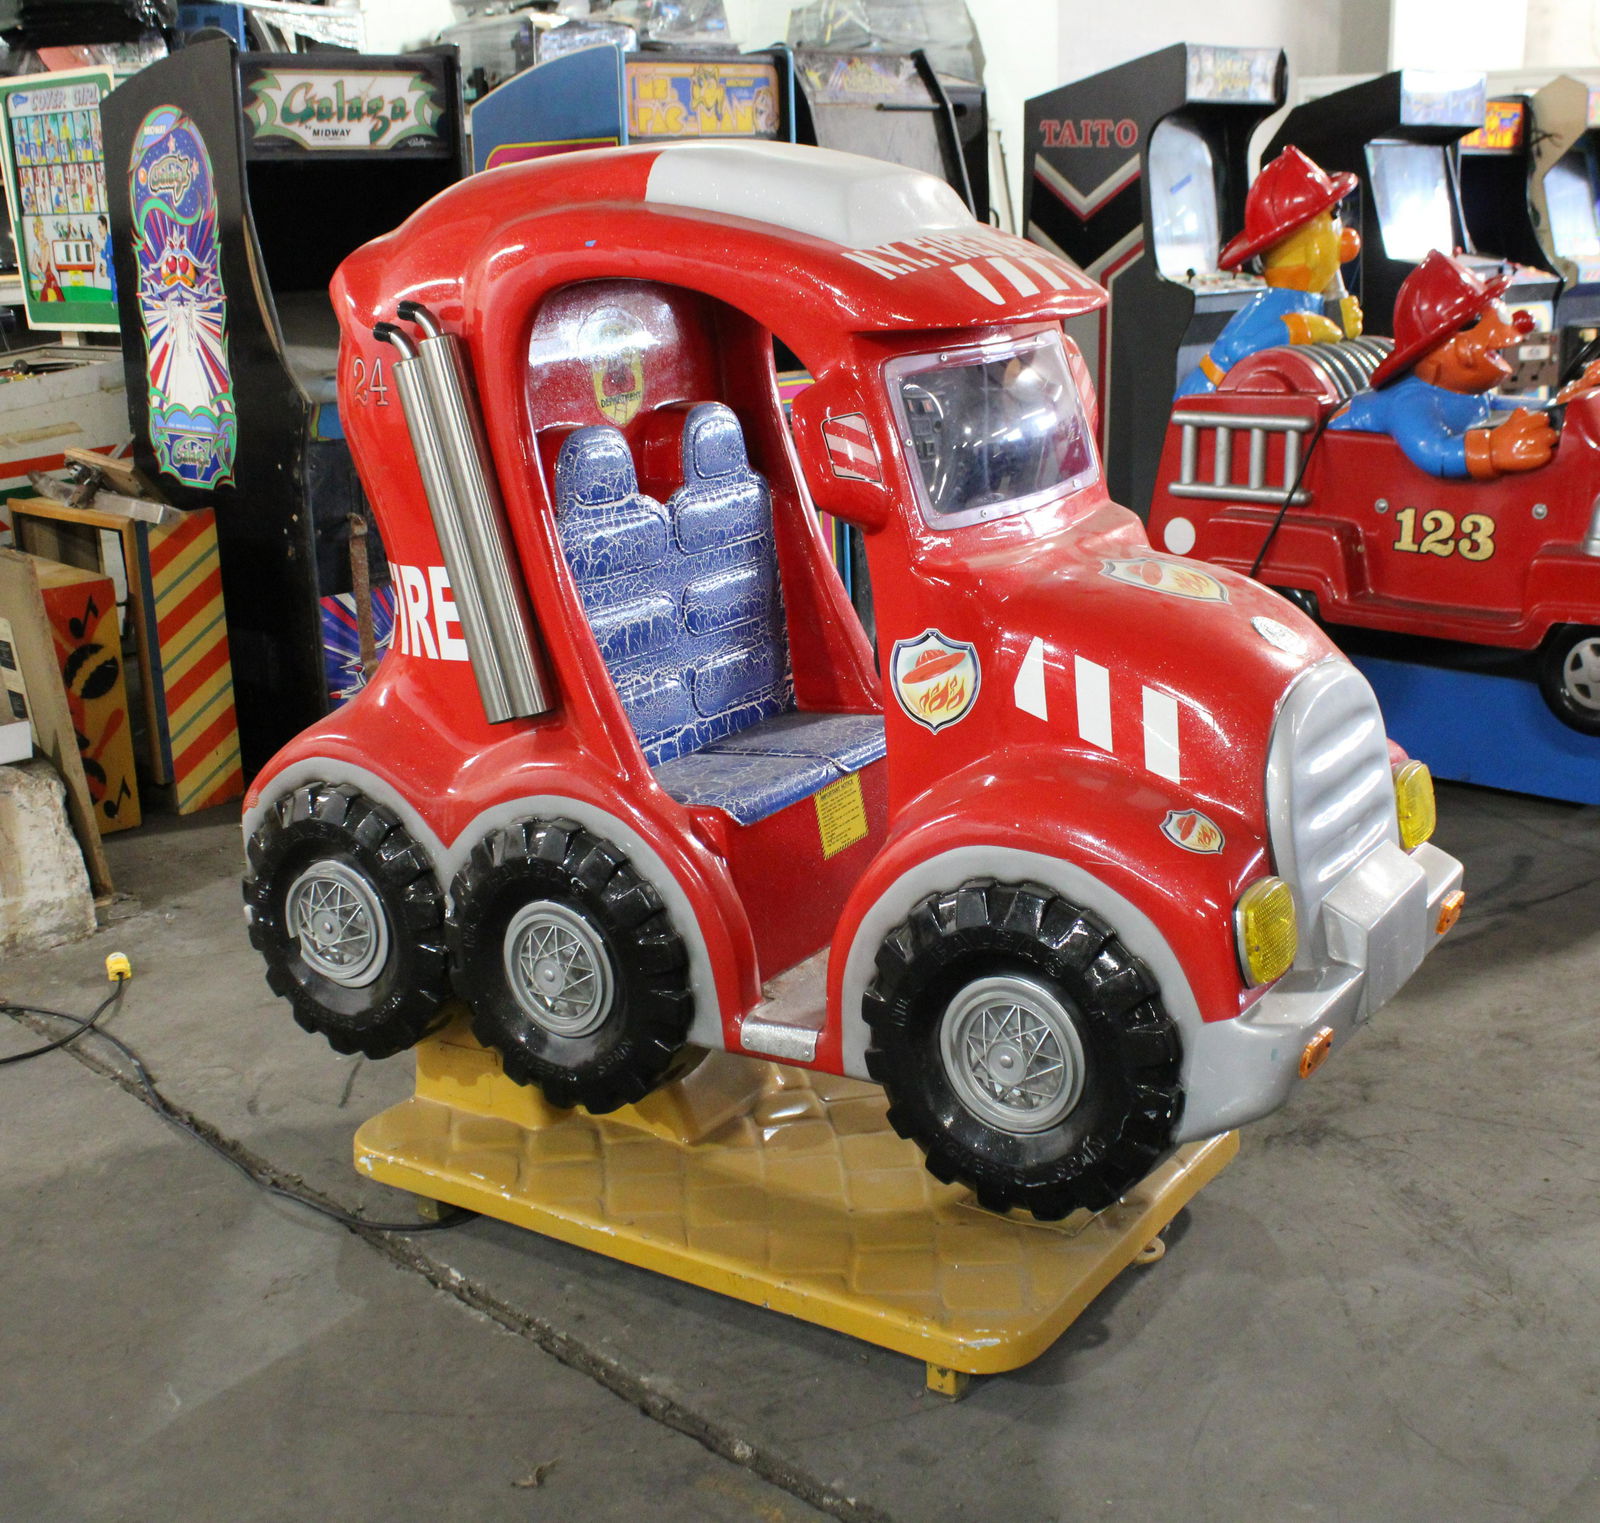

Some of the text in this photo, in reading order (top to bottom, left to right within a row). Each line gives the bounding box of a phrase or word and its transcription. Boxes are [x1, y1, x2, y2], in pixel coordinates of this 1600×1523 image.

[281, 79, 412, 145] Galaga
[312, 128, 351, 137] MIDWAY
[1039, 119, 1138, 148] TAITO
[353, 357, 388, 405] 24
[1394, 508, 1496, 561] 123
